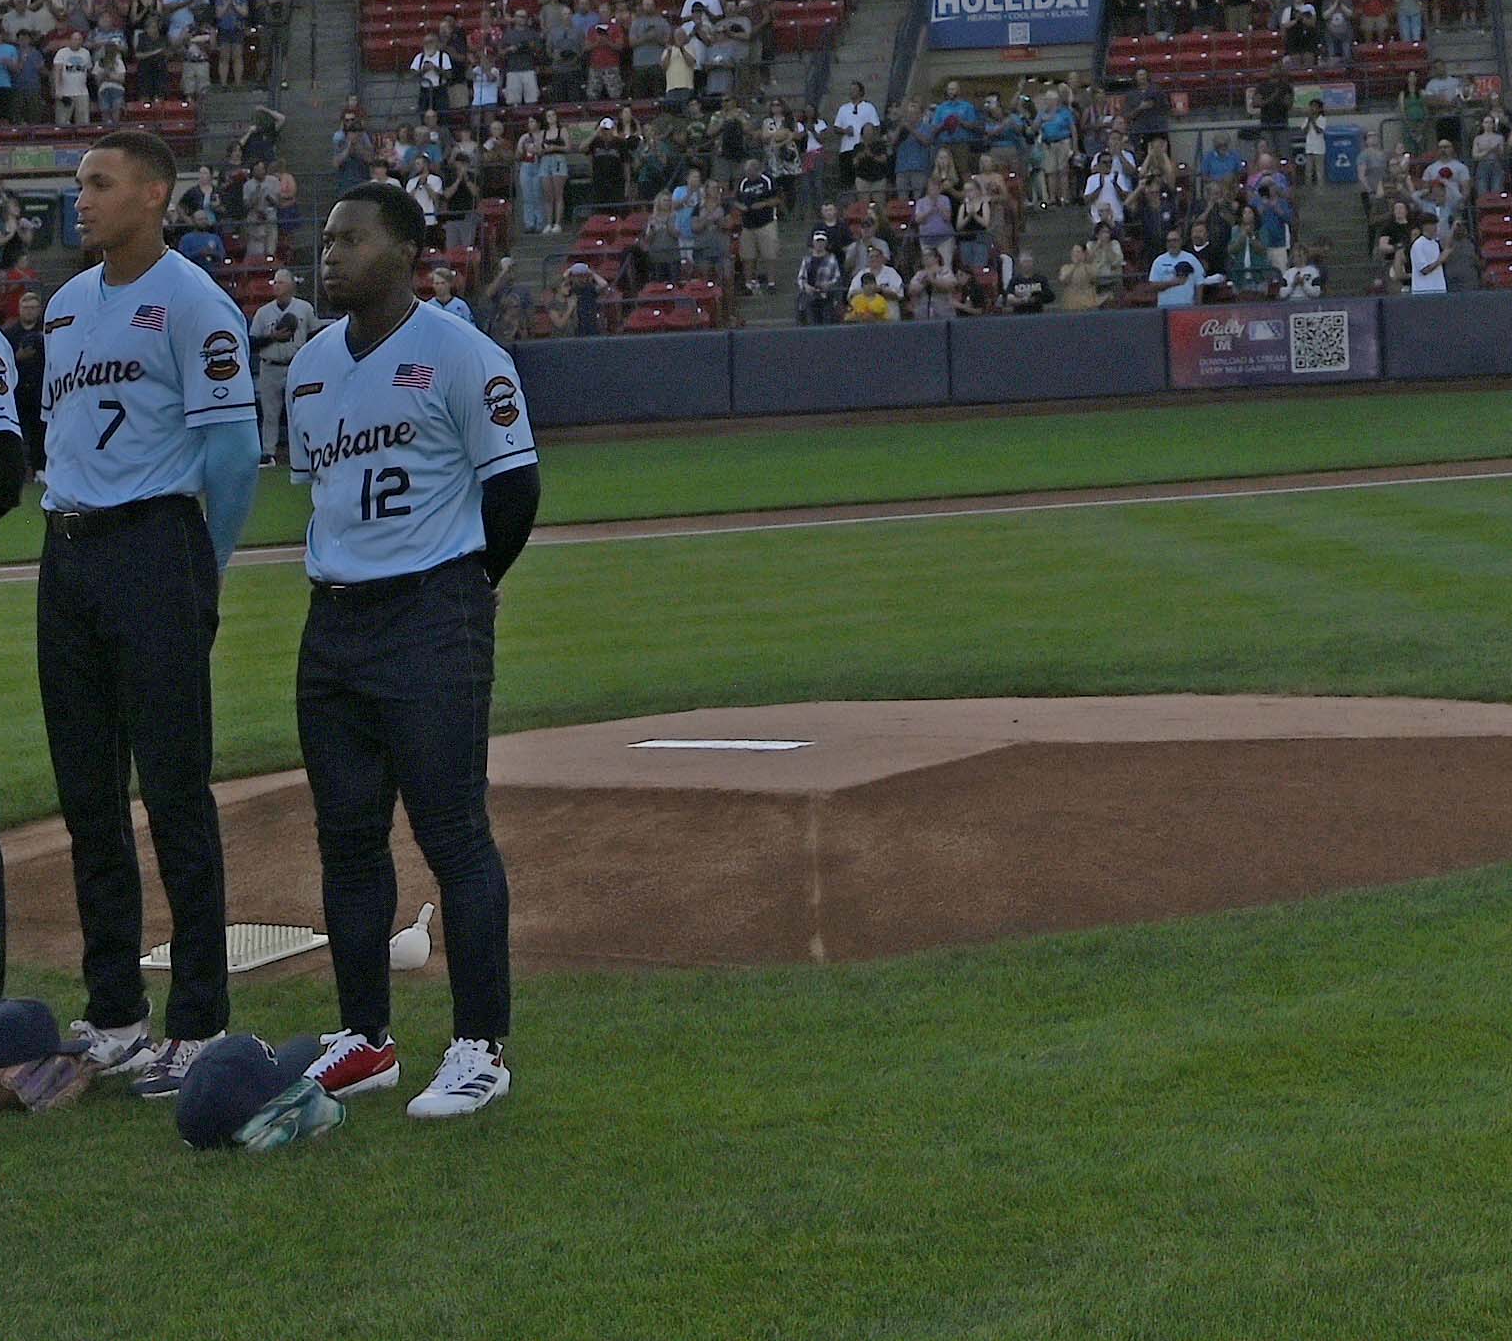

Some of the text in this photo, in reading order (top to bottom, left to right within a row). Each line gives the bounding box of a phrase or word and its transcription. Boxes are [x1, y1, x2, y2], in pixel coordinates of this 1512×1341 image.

[1199, 318, 1245, 338] Bally
[96, 400, 126, 450] 7
[361, 467, 412, 521] 12
